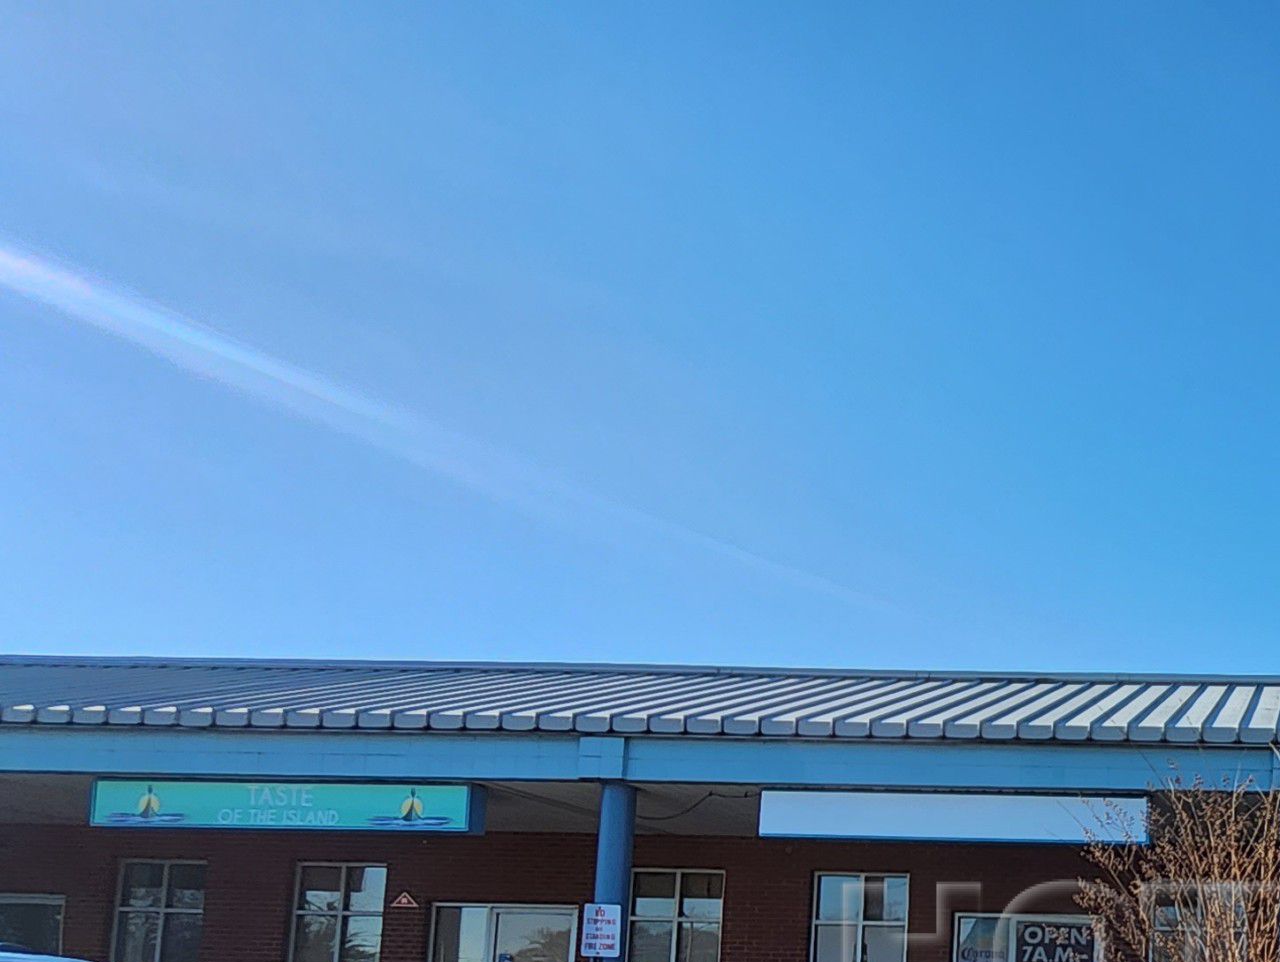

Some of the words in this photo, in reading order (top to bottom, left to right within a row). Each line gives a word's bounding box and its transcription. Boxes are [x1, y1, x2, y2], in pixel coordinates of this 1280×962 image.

[247, 785, 314, 807] TASTE
[217, 808, 243, 824] OF
[248, 809, 277, 825] THE
[281, 809, 339, 826] ISLAND
[1023, 926, 1089, 945] OPEN
